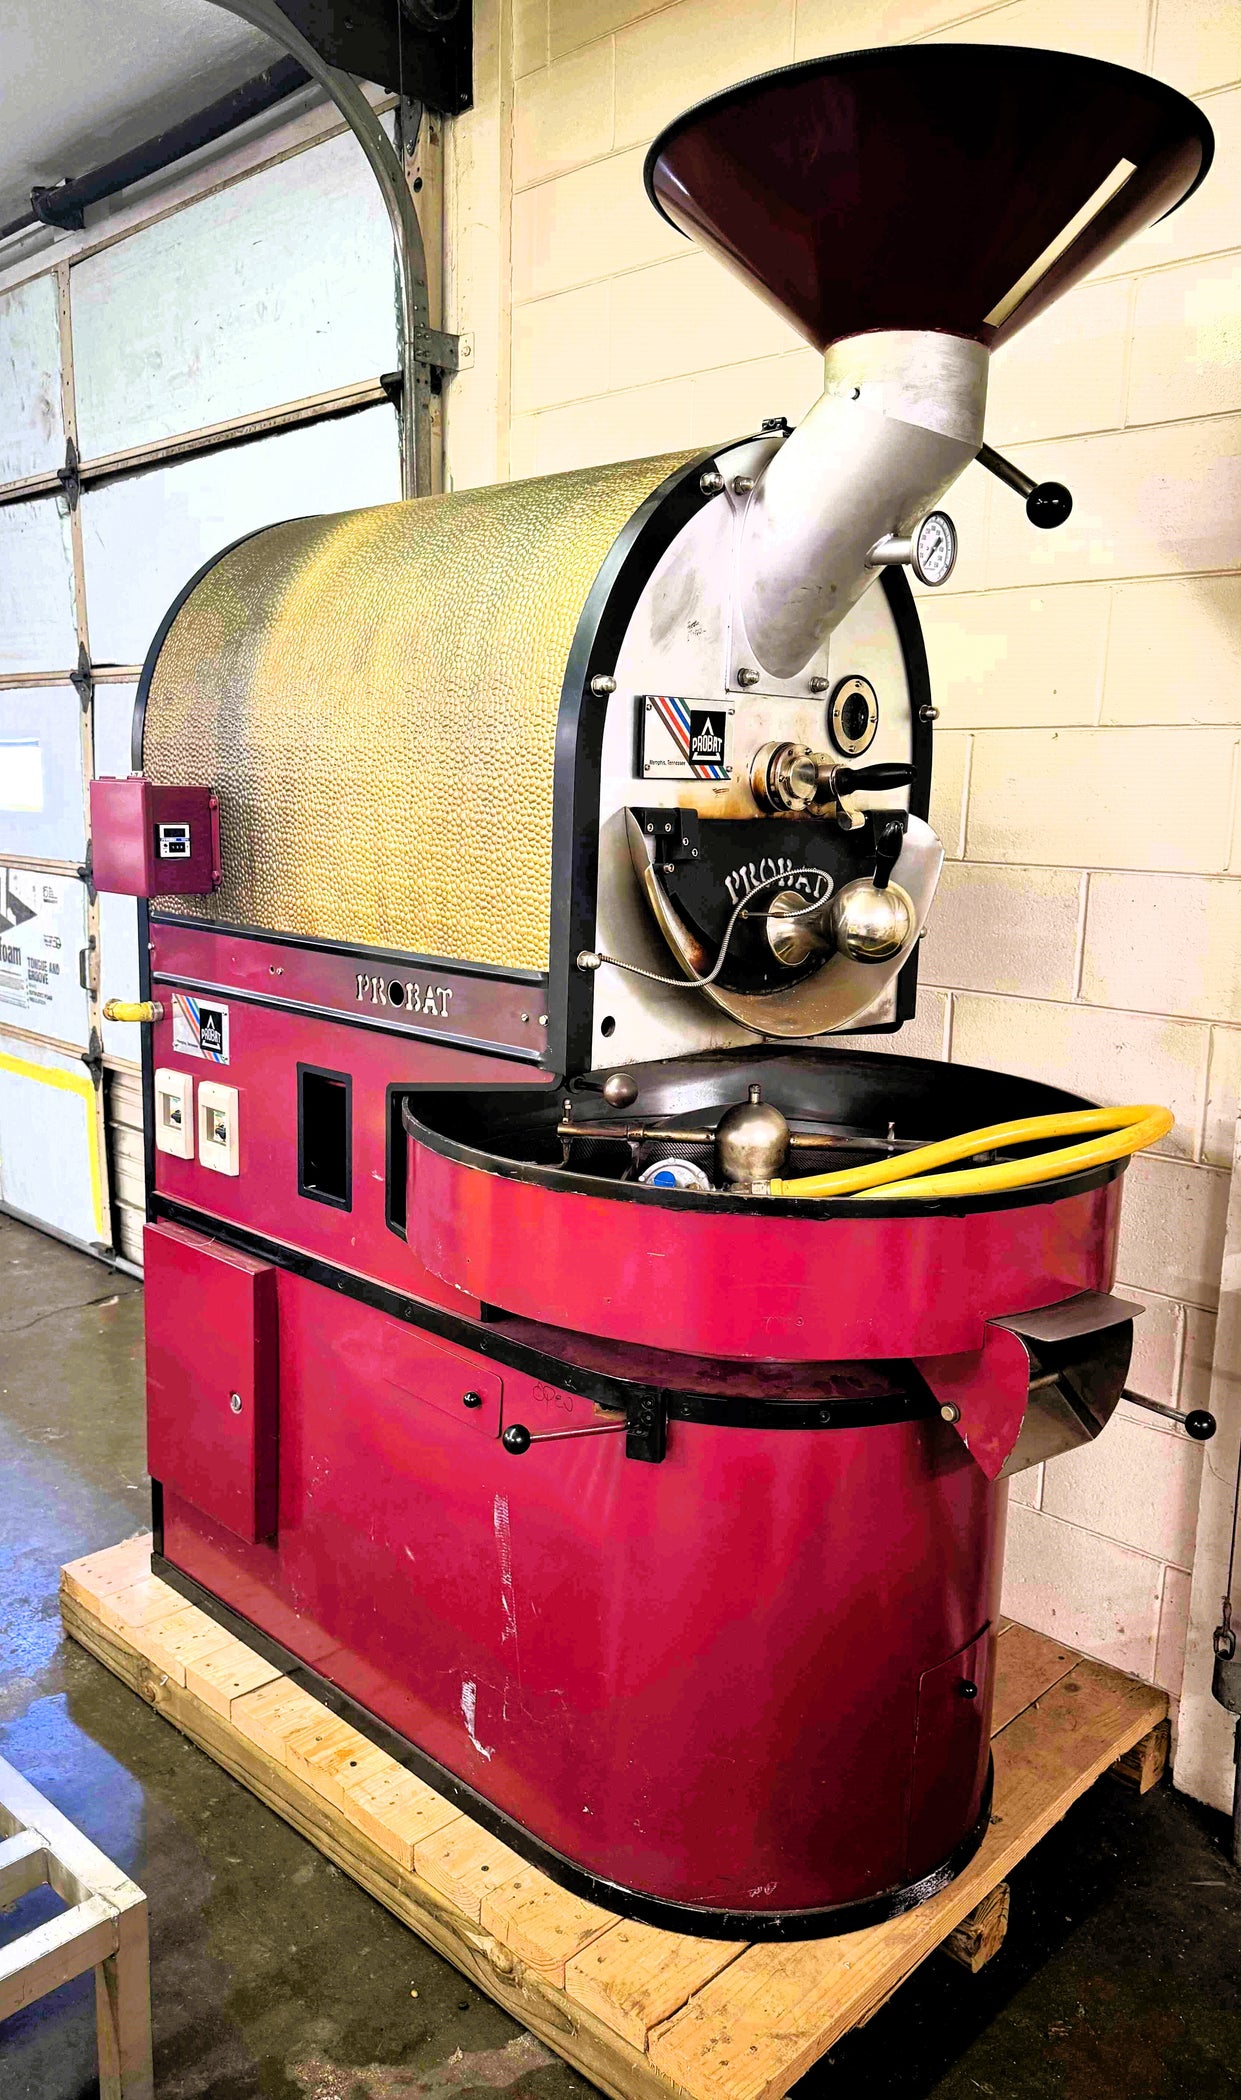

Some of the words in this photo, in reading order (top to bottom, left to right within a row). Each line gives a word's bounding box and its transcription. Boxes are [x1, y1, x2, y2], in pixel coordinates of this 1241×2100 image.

[692, 735, 723, 752] PROBAT
[724, 858, 828, 905] PROBAT
[356, 973, 453, 1017] PROBAT
[201, 1028, 222, 1044] PROBAT
